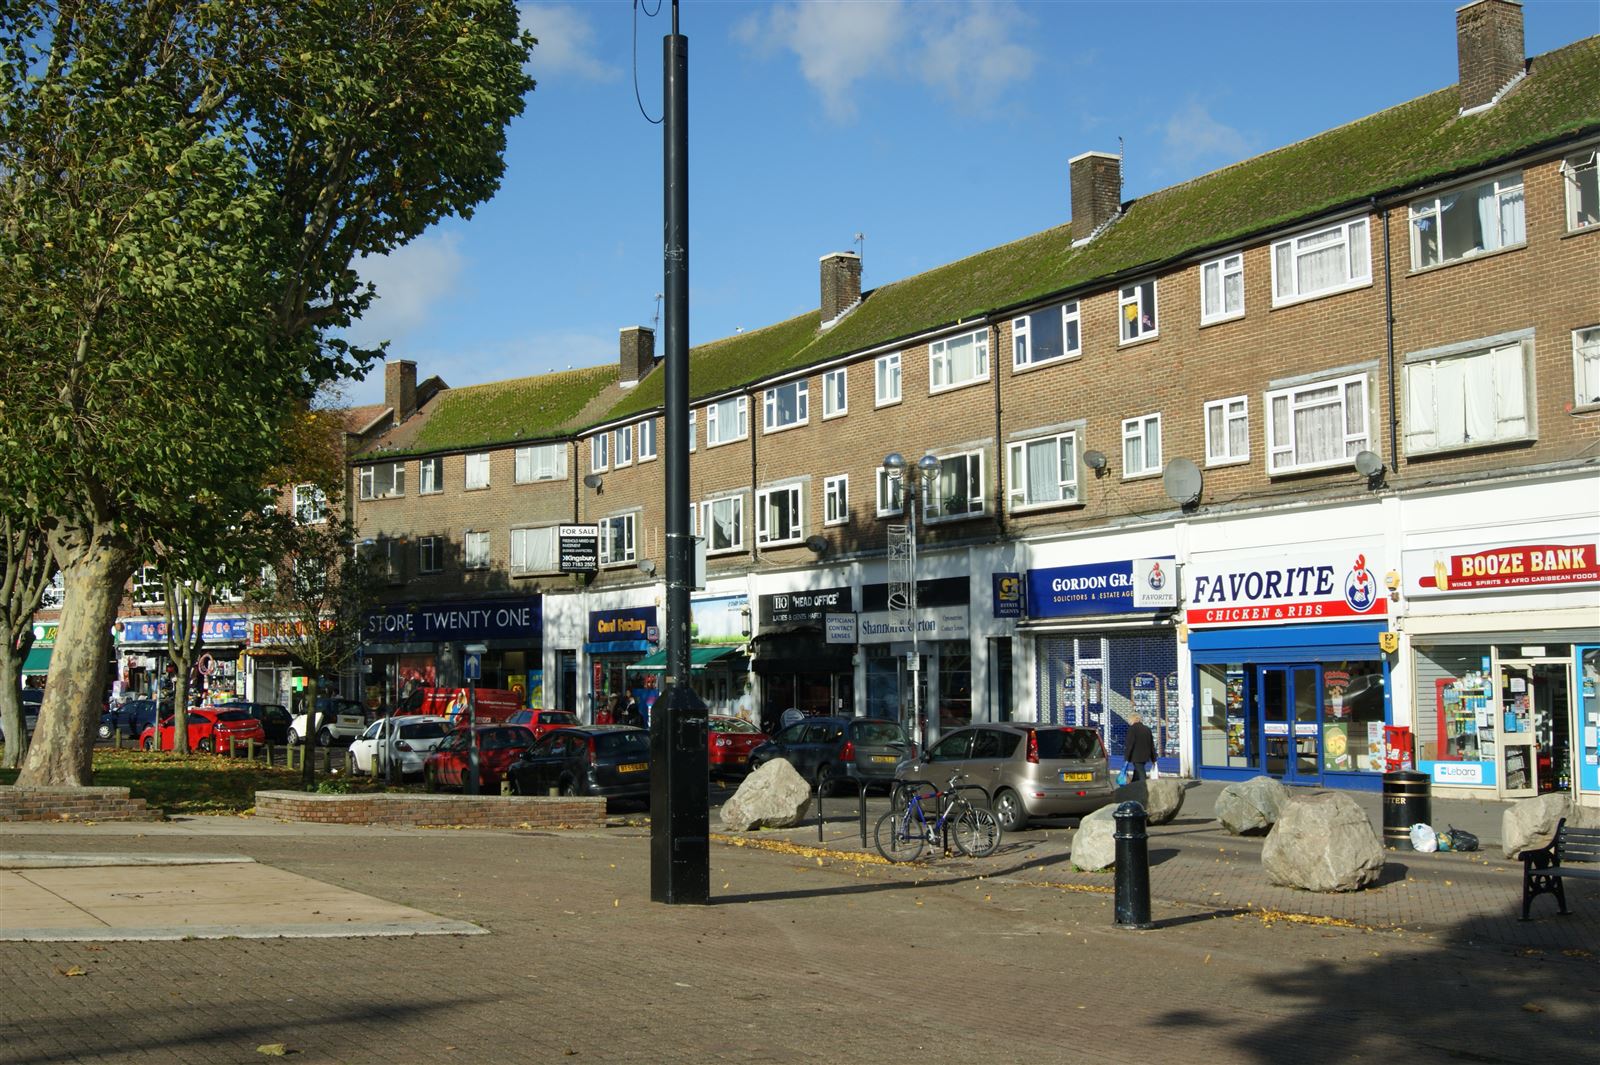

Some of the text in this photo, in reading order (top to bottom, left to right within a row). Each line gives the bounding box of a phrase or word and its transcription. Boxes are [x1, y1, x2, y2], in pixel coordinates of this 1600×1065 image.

[1461, 548, 1586, 577] BOOZE BANK
[1052, 575, 1107, 592] GORDON
[1192, 565, 1335, 604] FAVORITE
[1053, 594, 1088, 602] SOLICITORS
[368, 608, 530, 632] STORE TWENTY ONE
[1206, 604, 1323, 622] CHICKEN & RIBS
[1447, 767, 1476, 776] Lebara
